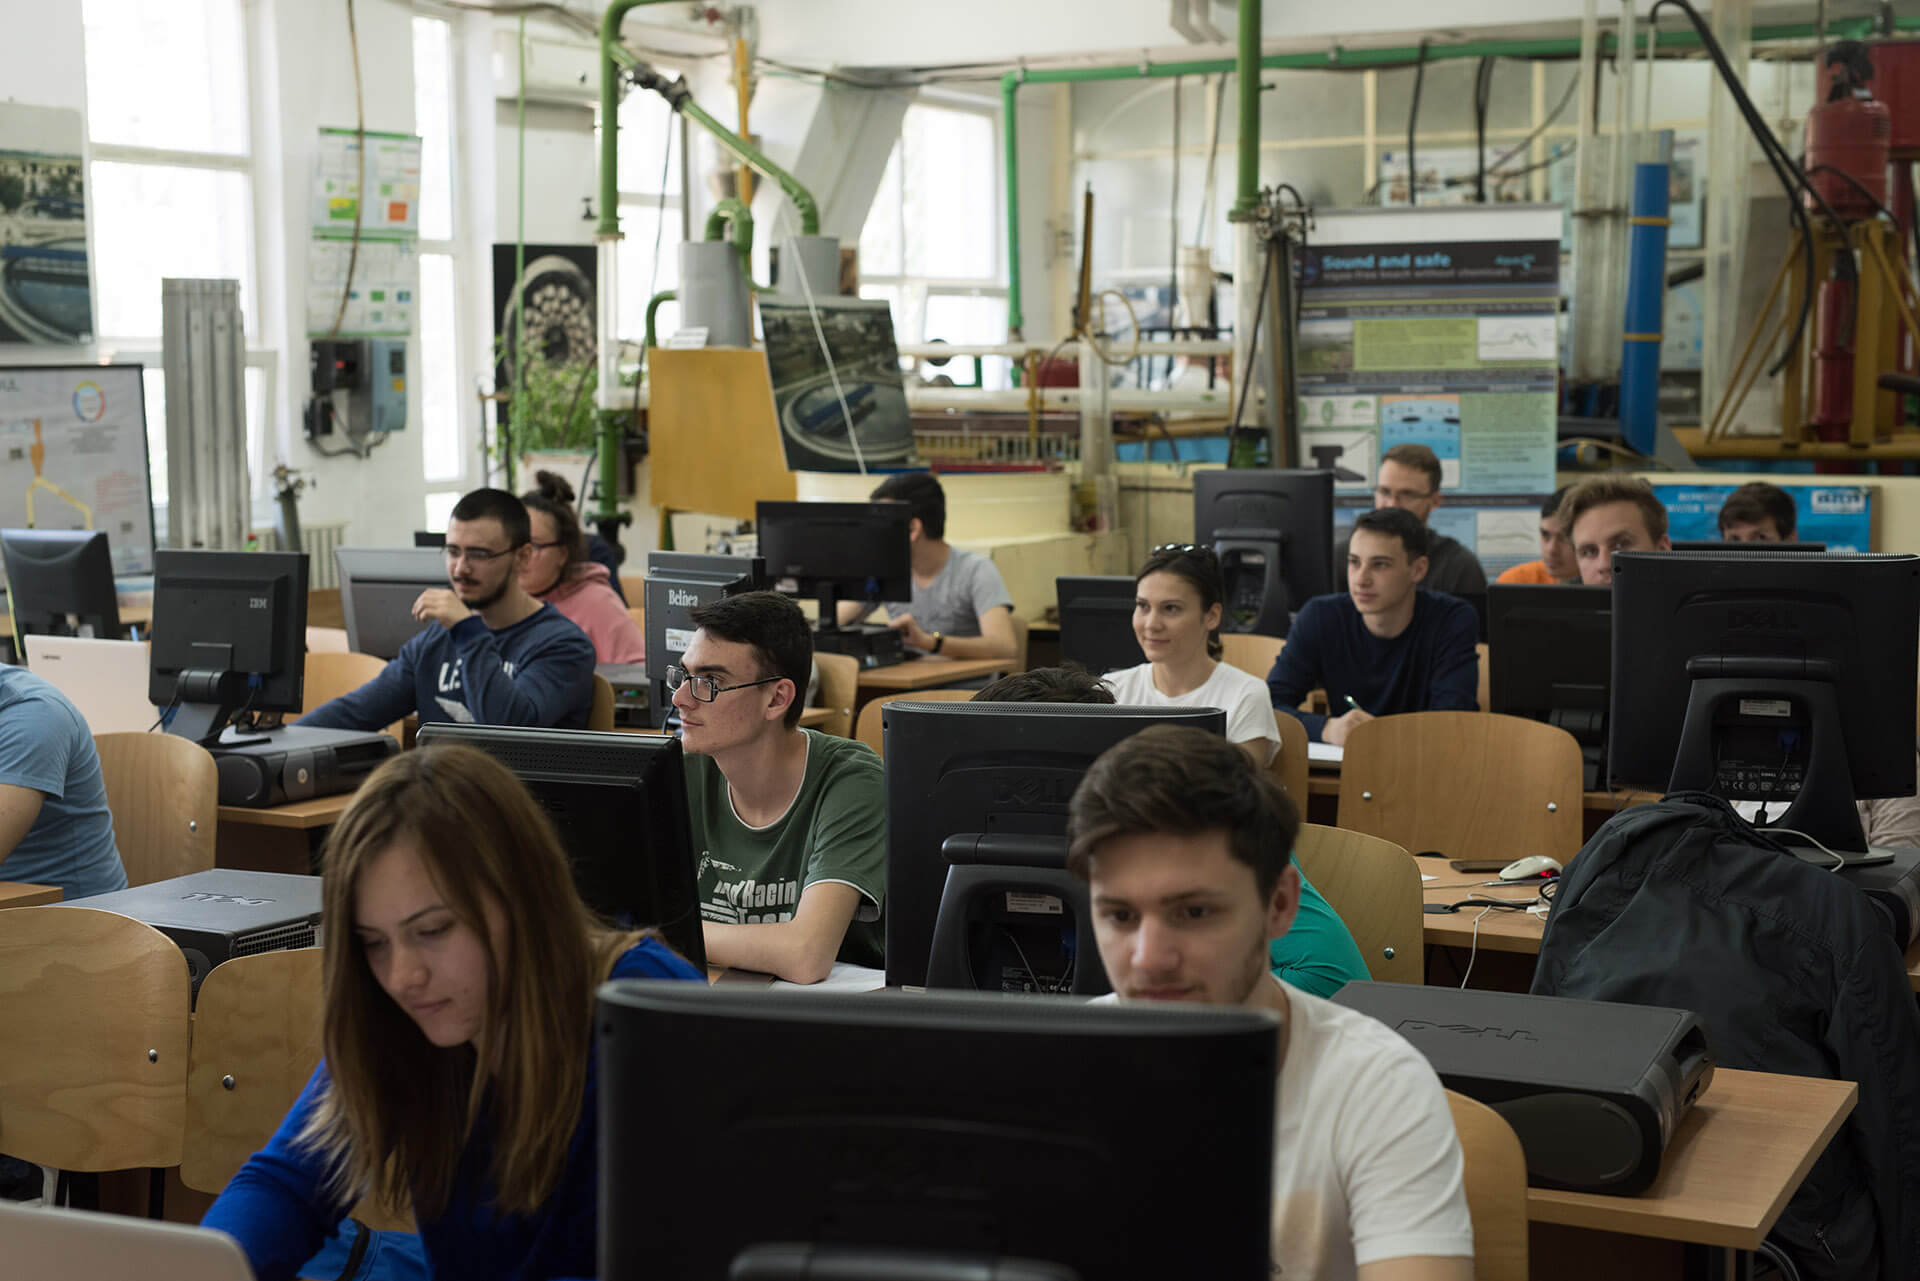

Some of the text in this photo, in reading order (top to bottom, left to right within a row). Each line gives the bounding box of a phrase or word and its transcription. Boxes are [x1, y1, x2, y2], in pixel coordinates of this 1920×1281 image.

[1322, 252, 1452, 270] Sound and safe
[249, 598, 268, 609] IBM
[668, 589, 699, 607] Belinea
[741, 877, 798, 908] Racin
